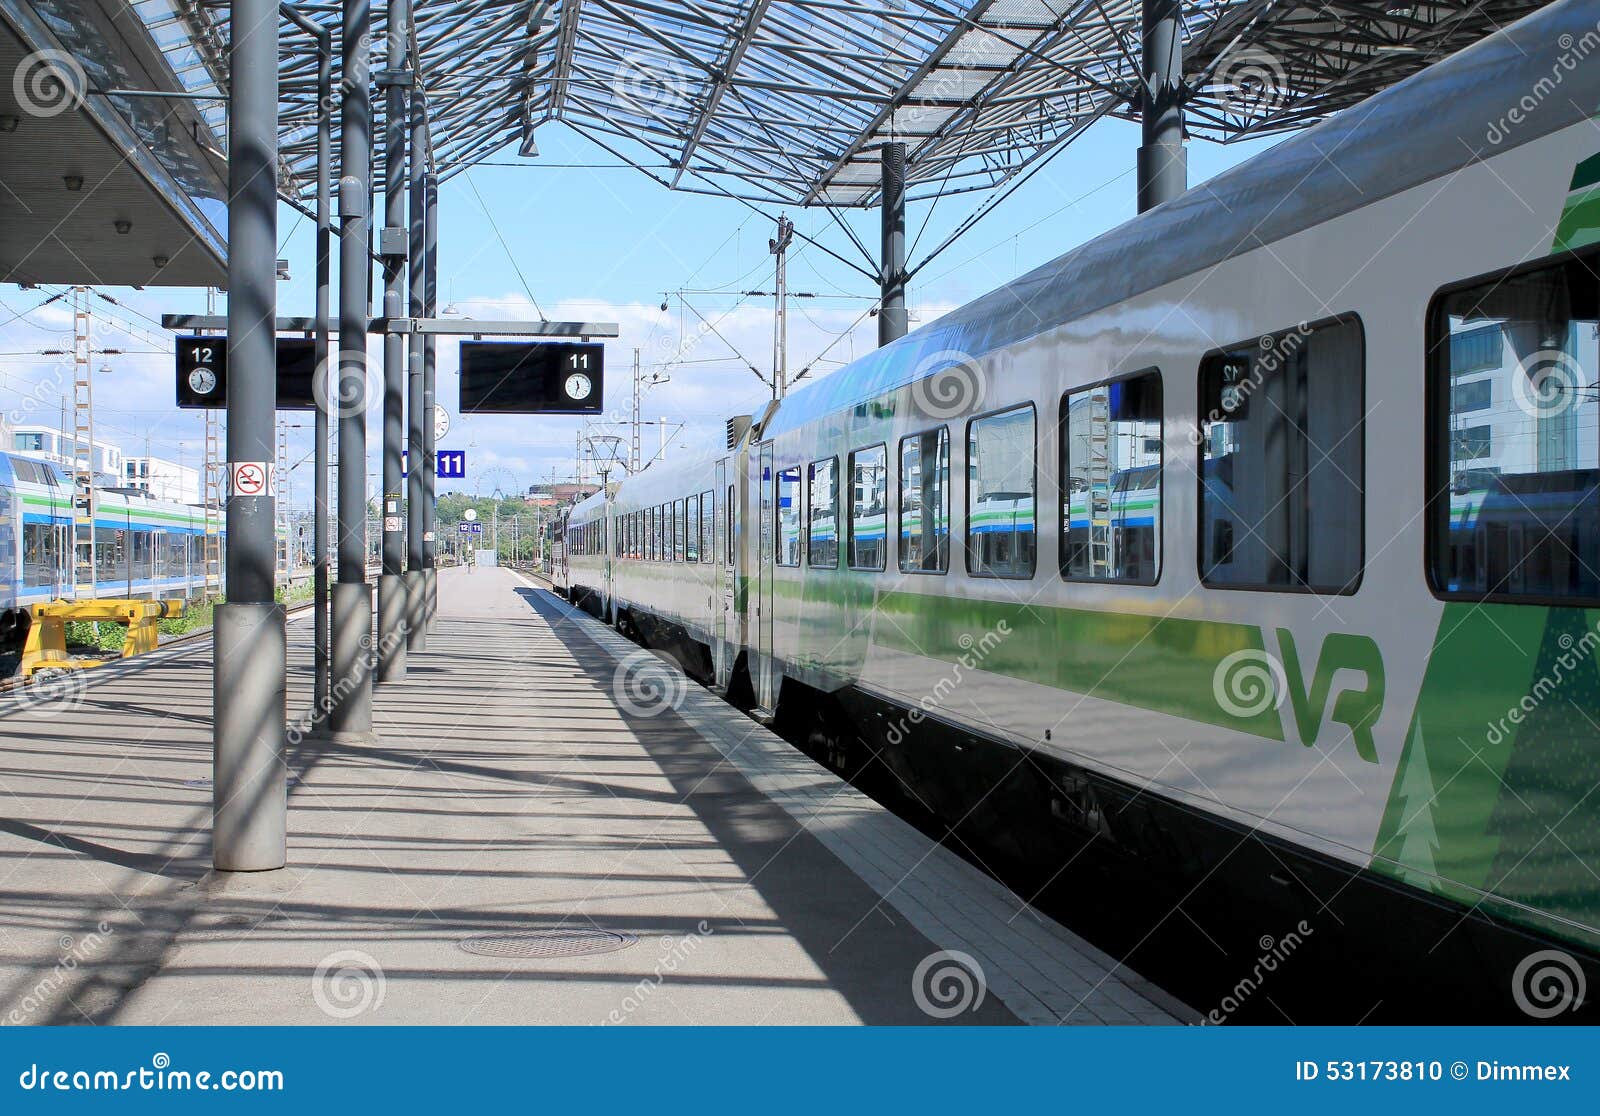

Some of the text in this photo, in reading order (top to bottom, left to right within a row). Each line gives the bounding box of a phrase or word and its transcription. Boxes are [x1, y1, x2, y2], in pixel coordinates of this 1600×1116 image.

[191, 347, 213, 362] 12
[570, 353, 588, 369] 11
[440, 455, 462, 474] 11
[1275, 627, 1386, 765] VR
